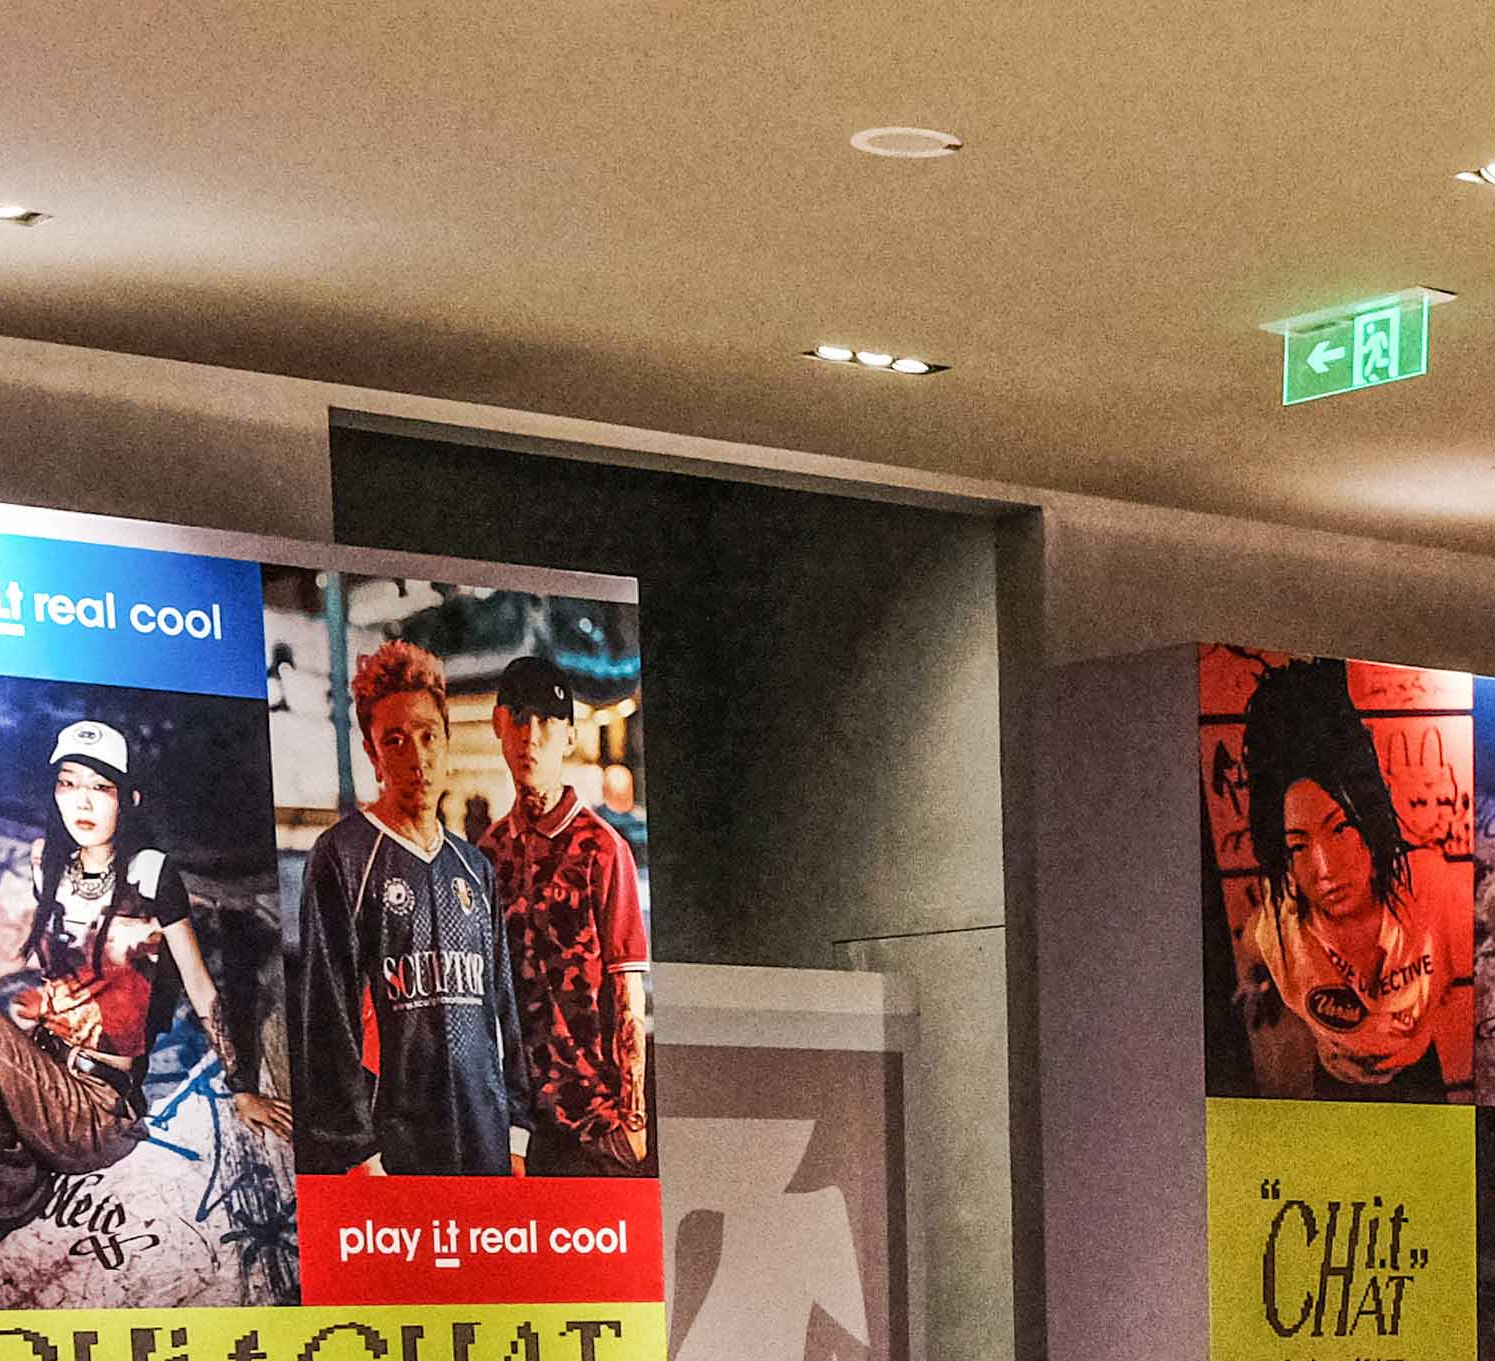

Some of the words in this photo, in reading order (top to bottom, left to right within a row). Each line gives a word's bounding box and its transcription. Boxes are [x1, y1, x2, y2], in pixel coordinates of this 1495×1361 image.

[33, 588, 117, 630] real
[129, 597, 223, 641] cool
[340, 1221, 422, 1261] play
[468, 1219, 539, 1256] real
[548, 1219, 628, 1256] cool
